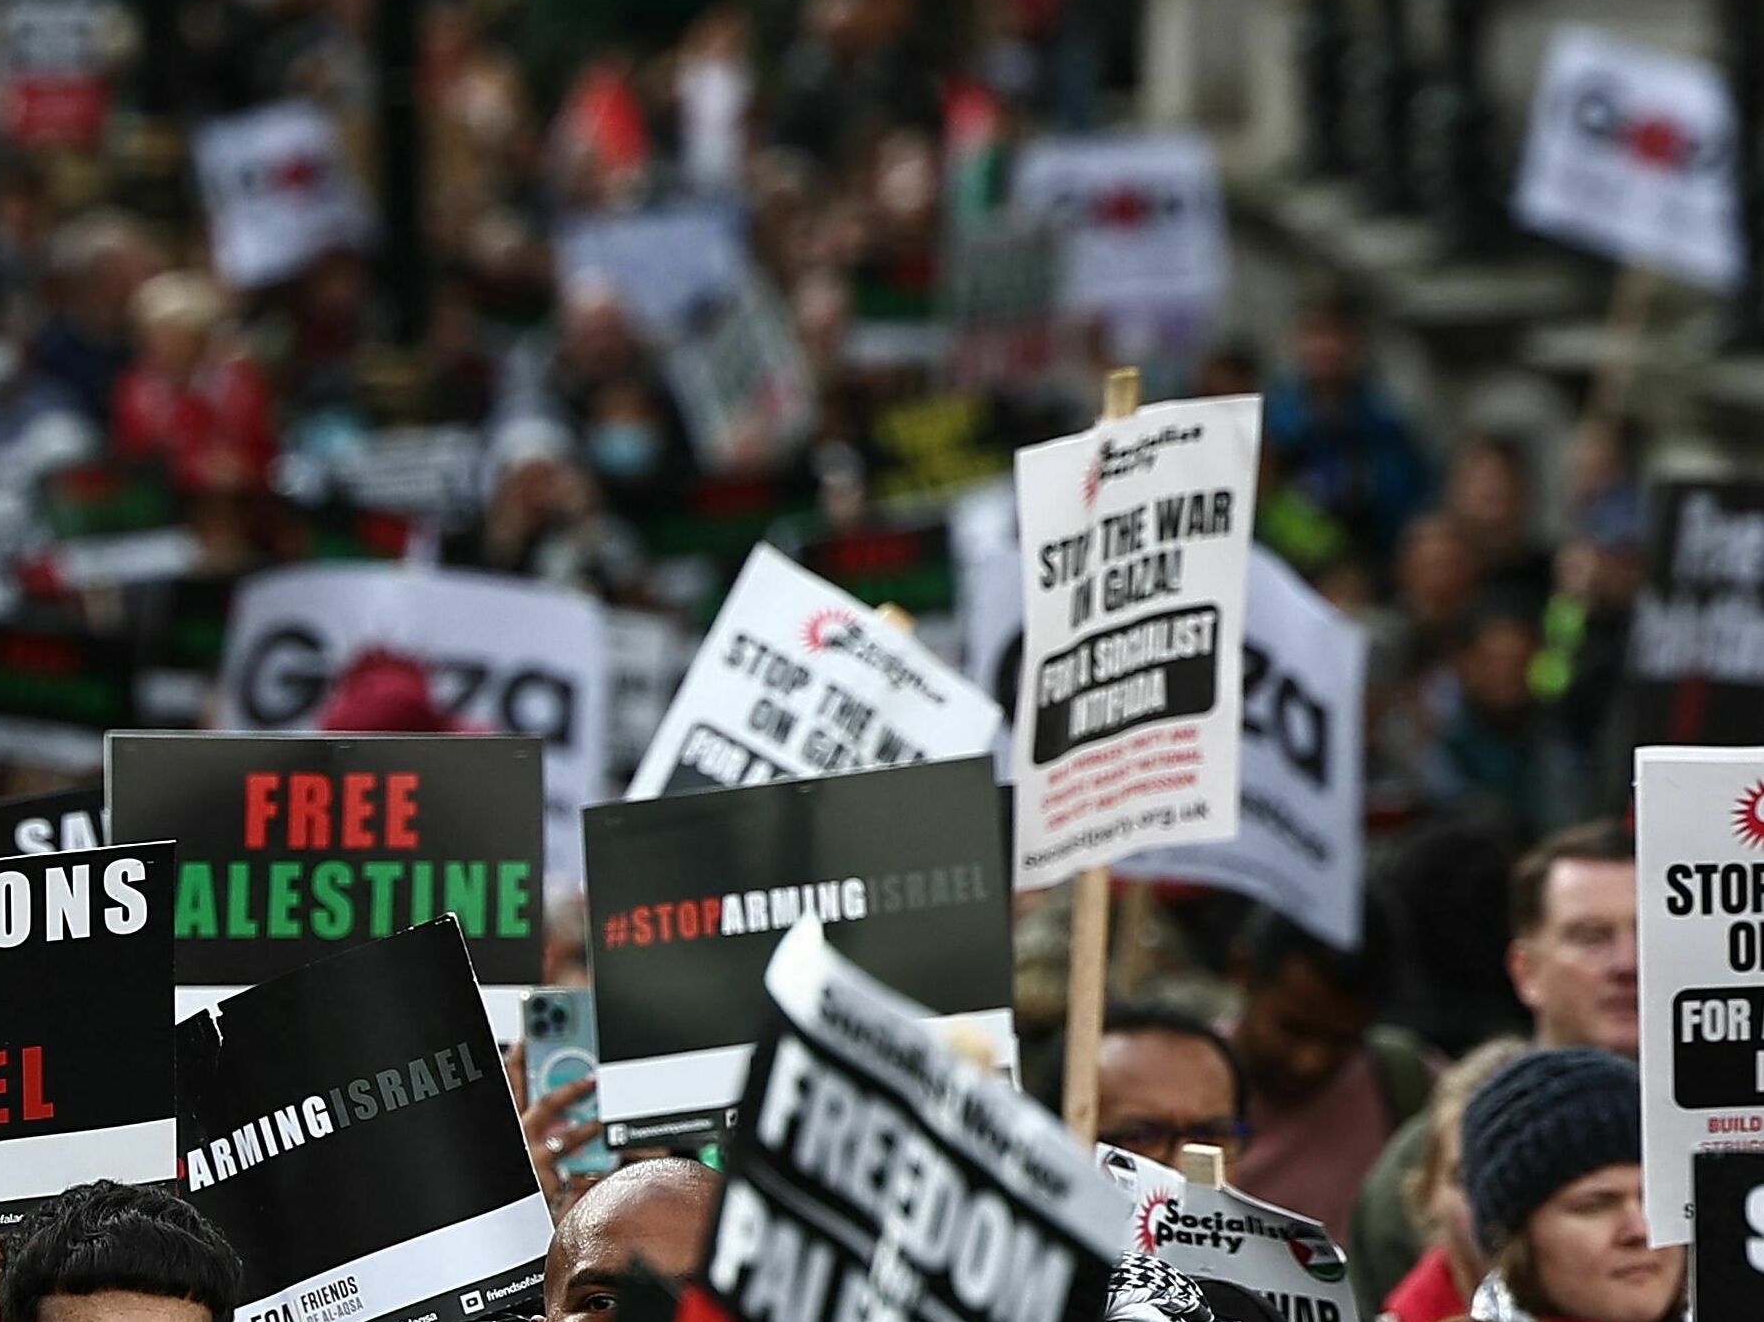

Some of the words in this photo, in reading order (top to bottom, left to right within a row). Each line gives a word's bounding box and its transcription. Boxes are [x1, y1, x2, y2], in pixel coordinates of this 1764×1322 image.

[1155, 489, 1232, 543] WAR
[239, 622, 577, 749] Gza
[243, 771, 421, 851] FREE
[174, 859, 532, 941] ALESTINE
[1680, 1000, 1752, 1045] FOR
[1707, 1115, 1763, 1135] BUILD
[1164, 1197, 1289, 1241] Socialist
[300, 1274, 360, 1314] FRIENDS
